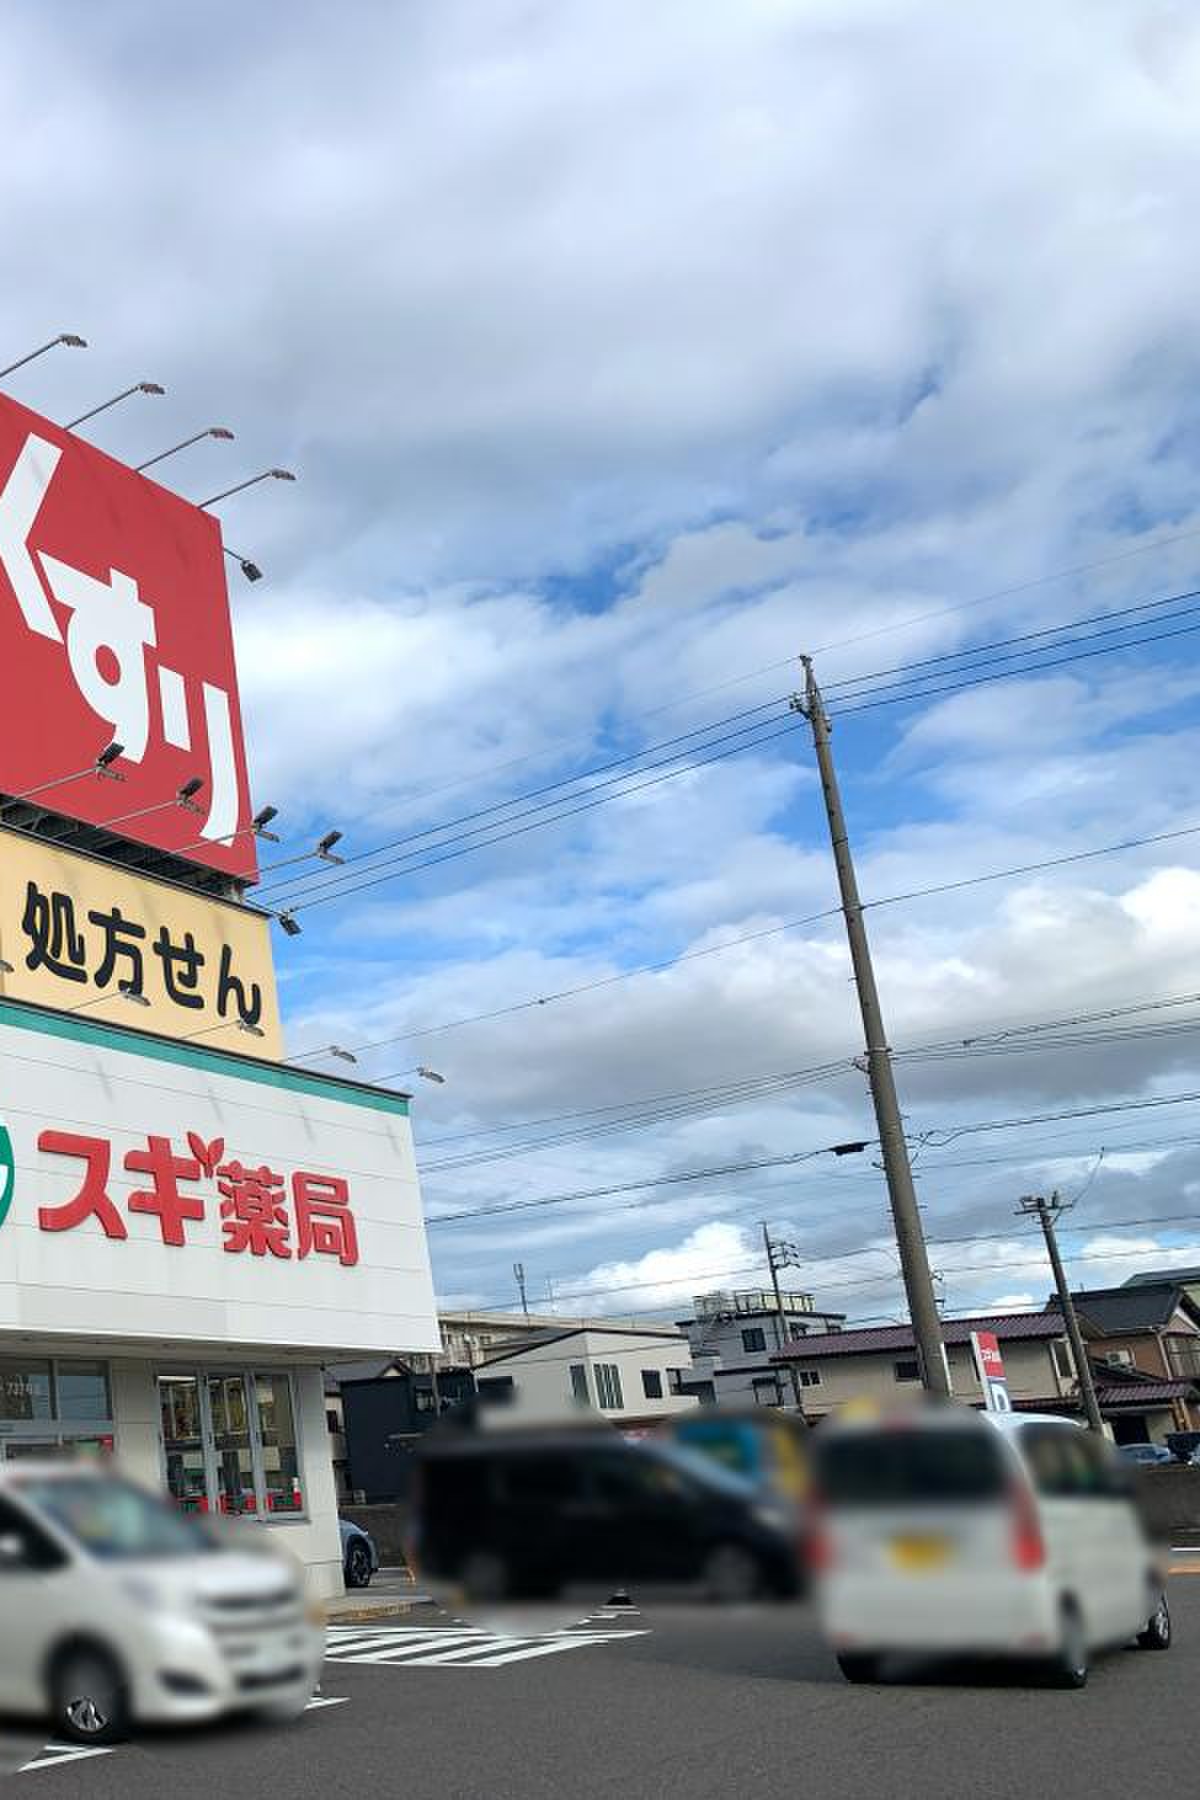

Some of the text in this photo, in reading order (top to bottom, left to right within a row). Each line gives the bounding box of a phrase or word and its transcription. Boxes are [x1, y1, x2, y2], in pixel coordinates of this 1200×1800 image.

[21, 881, 263, 1024] 処方せん
[37, 1129, 360, 1267] スギ薬局
